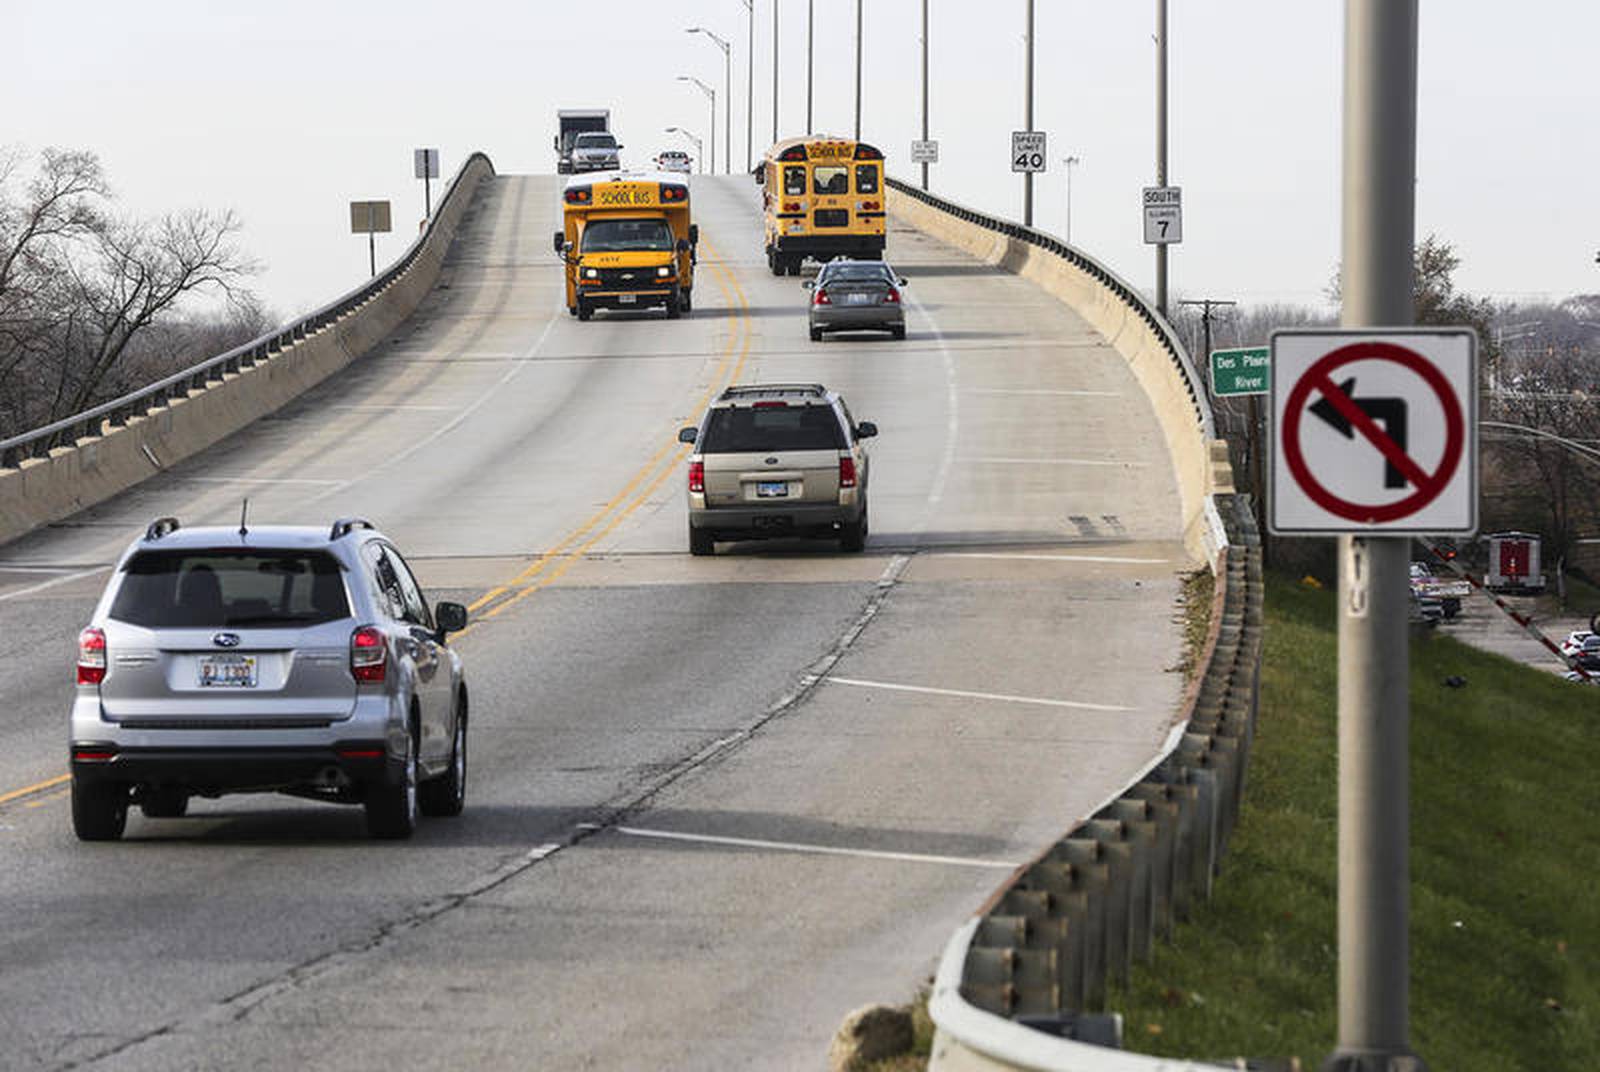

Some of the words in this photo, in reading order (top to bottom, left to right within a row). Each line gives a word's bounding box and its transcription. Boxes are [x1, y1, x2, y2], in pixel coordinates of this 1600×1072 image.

[1015, 135, 1042, 143] SPEED
[808, 144, 834, 159] SCHOOL
[837, 143, 852, 159] BUS
[1017, 143, 1040, 151] LIMIT
[1015, 153, 1043, 168] 40
[601, 191, 632, 205] SCHOOL
[633, 191, 650, 205] BUS
[1145, 191, 1180, 203] SOUTH
[1157, 220, 1169, 239] 7
[1216, 356, 1237, 369] Des
[1234, 375, 1262, 390] River
